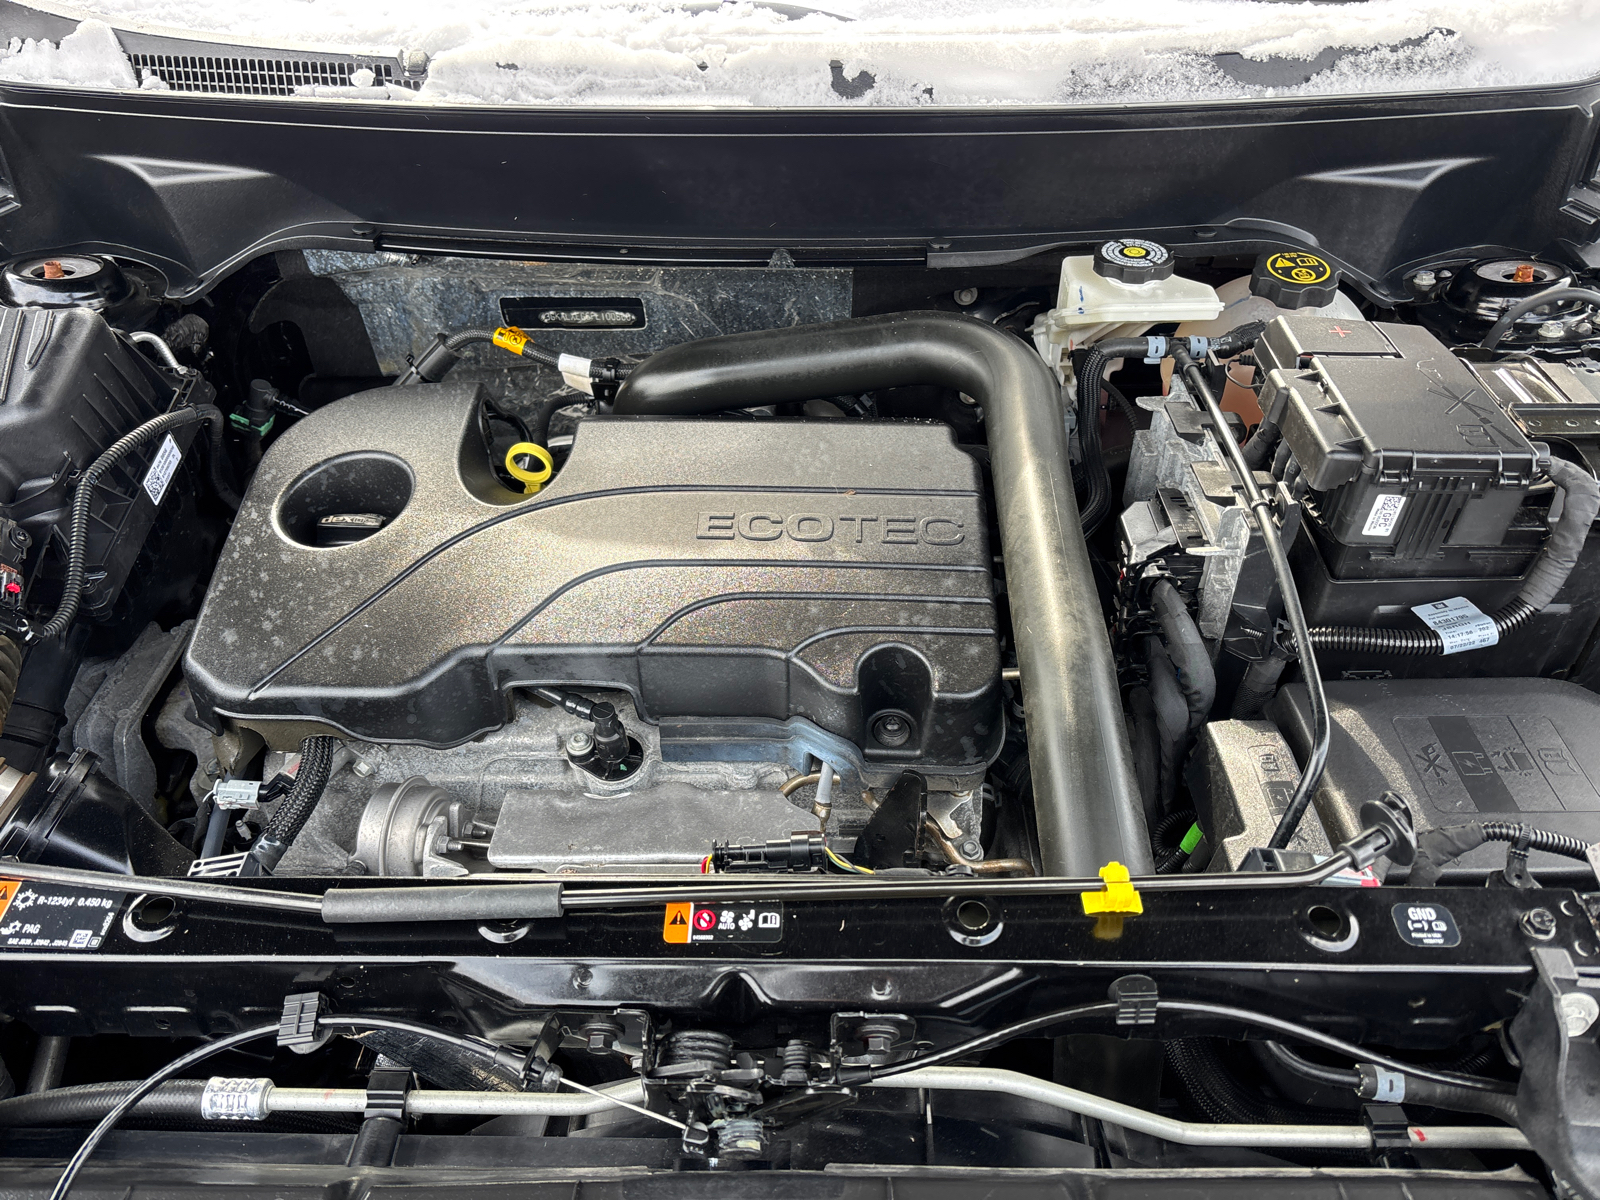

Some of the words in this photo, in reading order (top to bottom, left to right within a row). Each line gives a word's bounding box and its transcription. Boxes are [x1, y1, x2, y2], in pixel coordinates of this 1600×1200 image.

[1379, 512, 1391, 527] GPC
[696, 512, 966, 546] ECOTEC
[37, 896, 75, 907] R-1234yf
[77, 897, 101, 907] 0.450
[101, 898, 113, 909] kg
[1407, 906, 1437, 921] GND
[22, 924, 41, 934] PAG
[718, 922, 735, 930] AUTO
